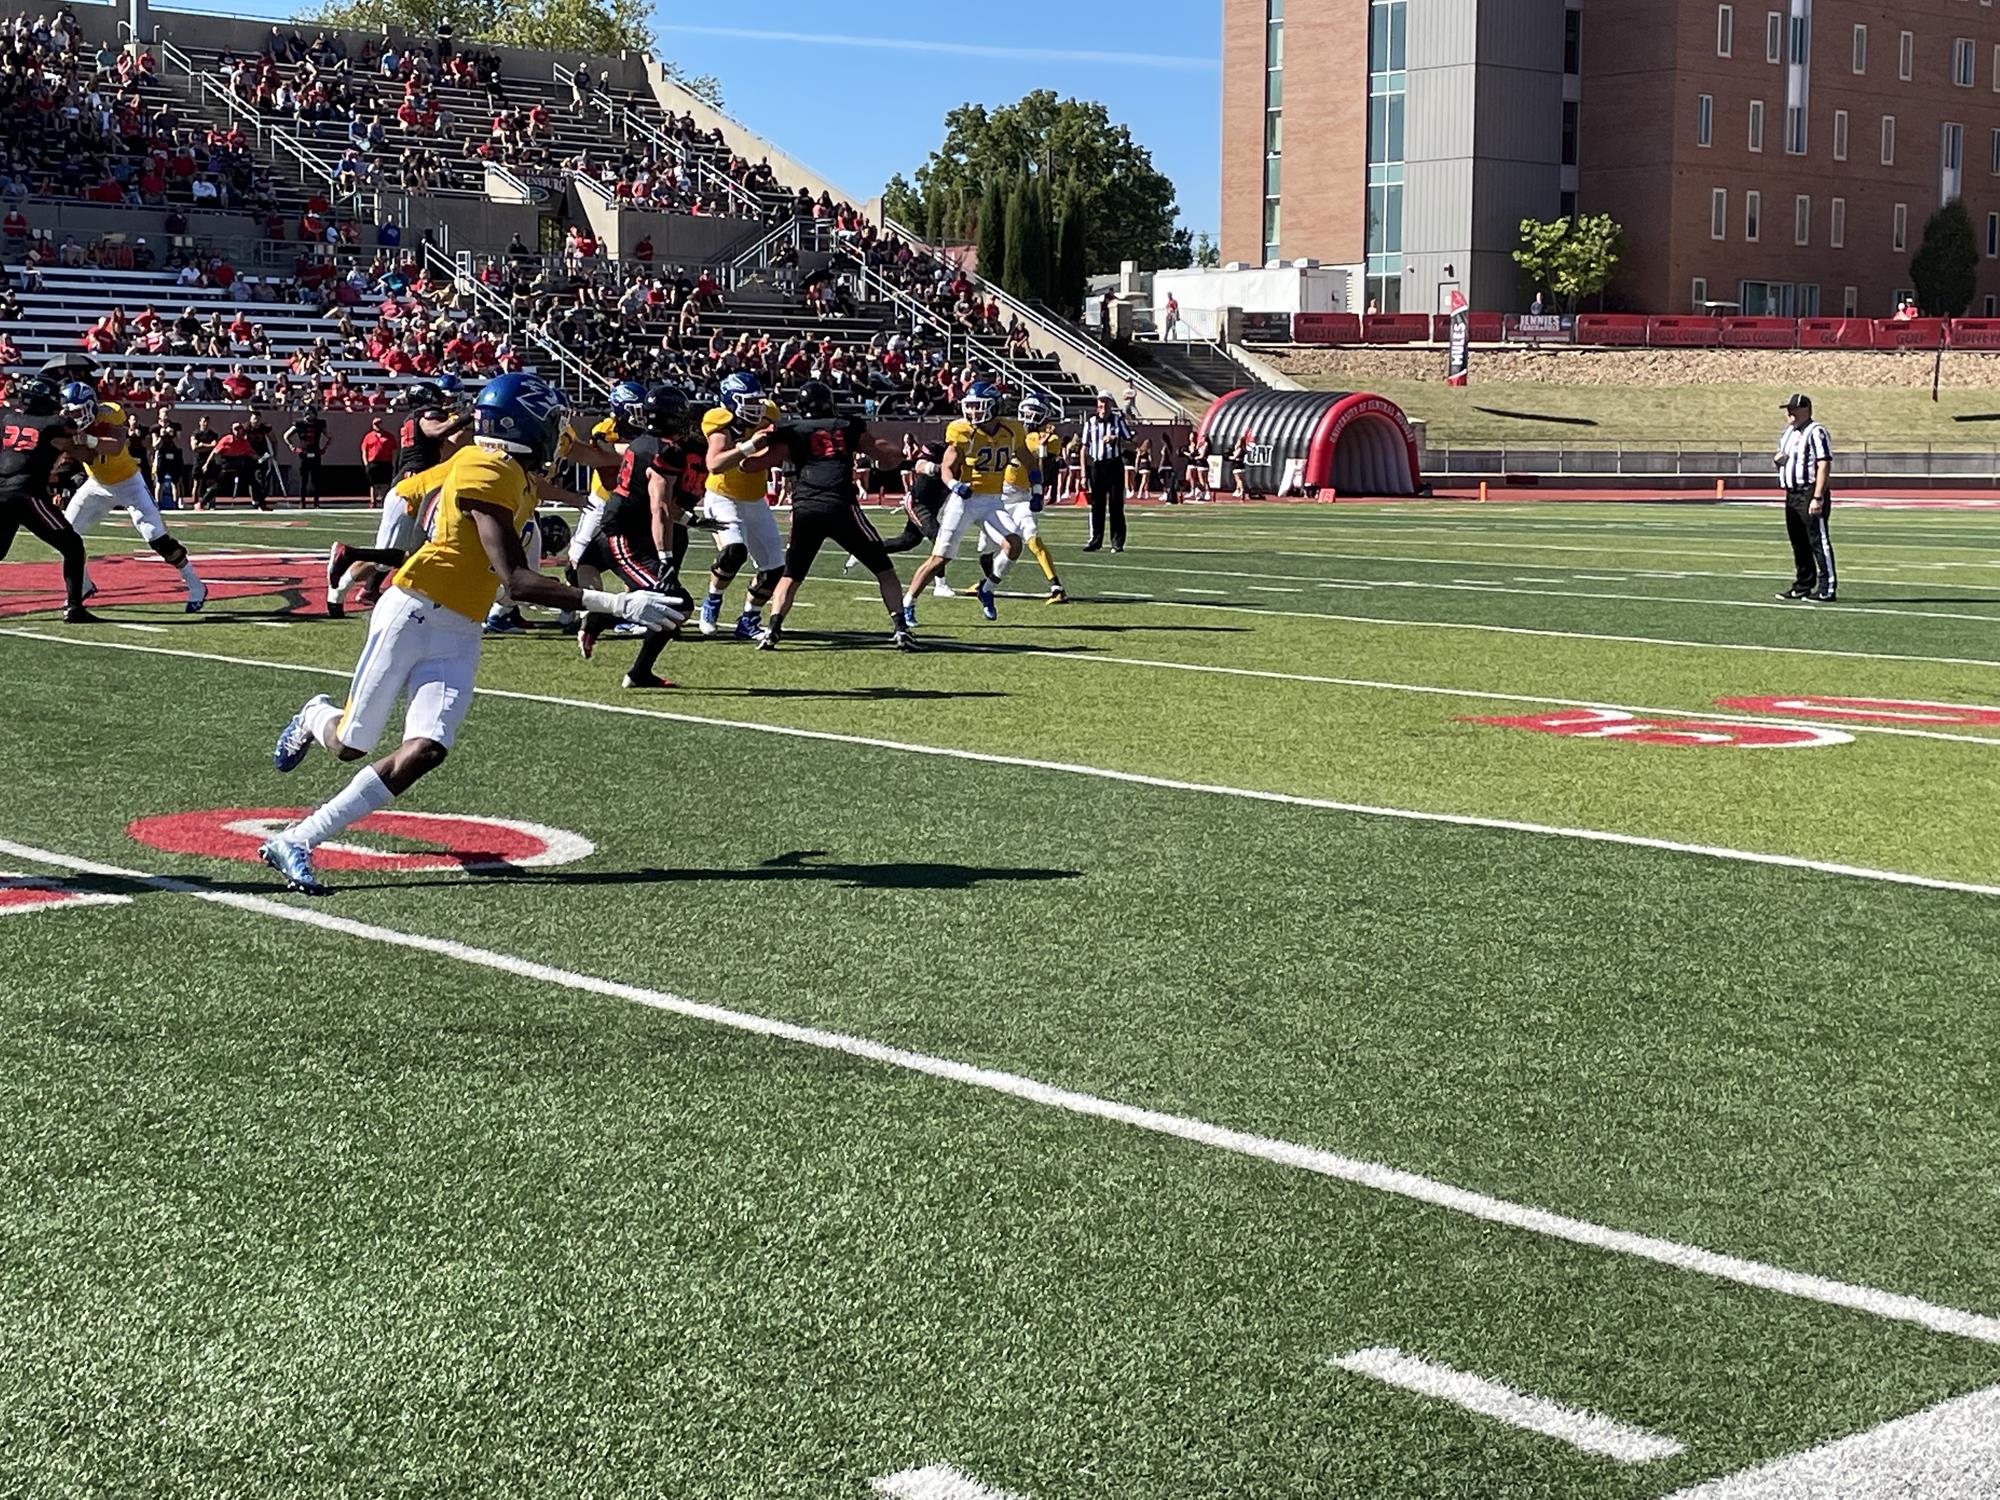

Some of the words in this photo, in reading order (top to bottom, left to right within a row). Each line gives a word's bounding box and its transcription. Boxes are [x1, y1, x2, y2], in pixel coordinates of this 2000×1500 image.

[1451, 322, 1466, 366] MULES
[1896, 331, 1927, 345] GOLF
[974, 447, 1010, 472] 20
